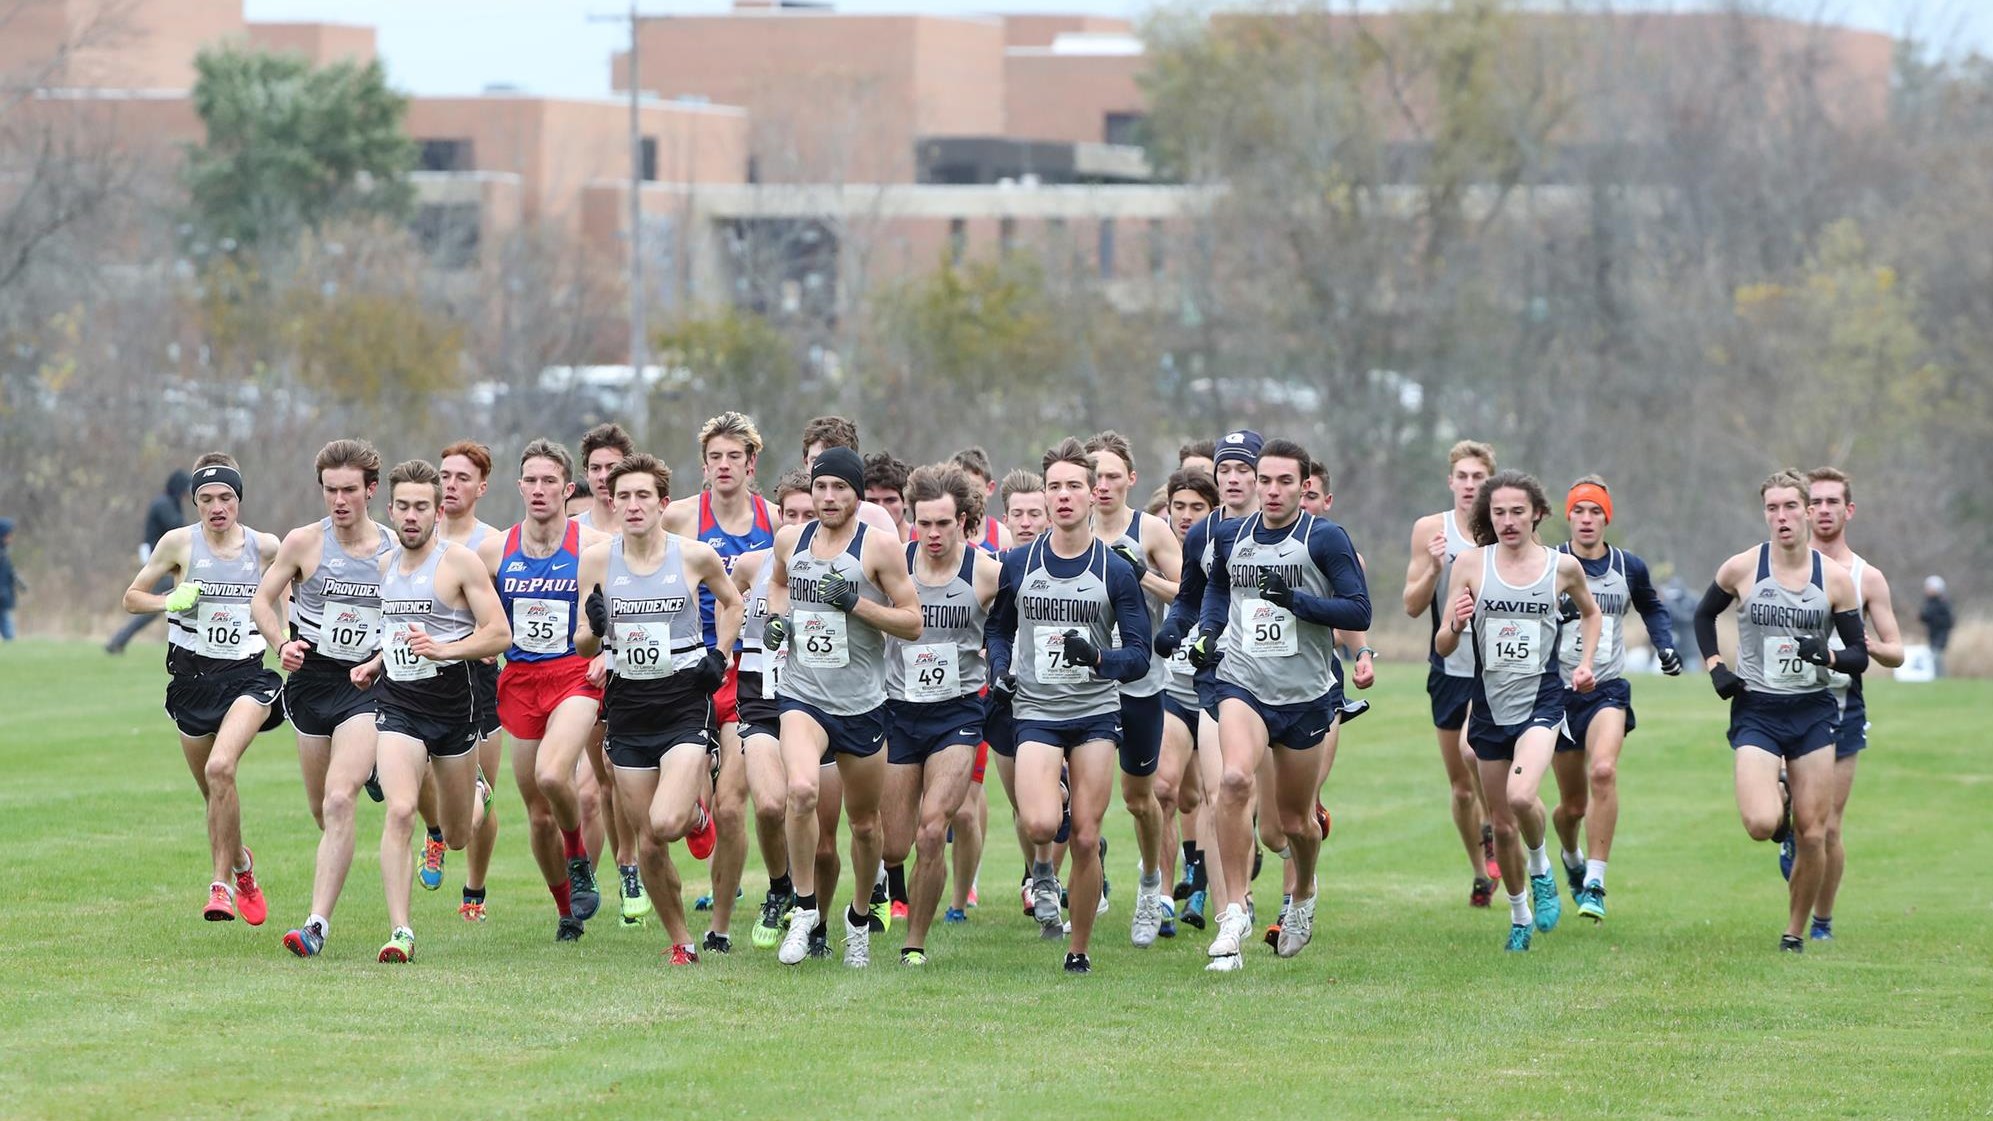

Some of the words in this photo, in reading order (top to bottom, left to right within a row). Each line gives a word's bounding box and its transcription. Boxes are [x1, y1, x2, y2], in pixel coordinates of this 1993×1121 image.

[320, 578, 380, 597] PROVIDEN
[789, 576, 859, 604] GEORGN
[611, 597, 685, 618] PROVIDENCE
[920, 604, 971, 628] GETOWN
[1023, 596, 1101, 623] GEORGETOWN
[1483, 599, 1549, 615] XAVIER
[1751, 603, 1824, 630] GEORGETOWN
[207, 626, 241, 645] 106
[331, 627, 368, 647] 107
[527, 620, 554, 639] 35
[1255, 623, 1281, 642] 50
[806, 635, 833, 653] 63
[1495, 641, 1530, 659] 145
[393, 647, 420, 665] 115
[626, 647, 660, 665] 109
[1779, 658, 1803, 674] 70
[918, 667, 945, 686] 49
